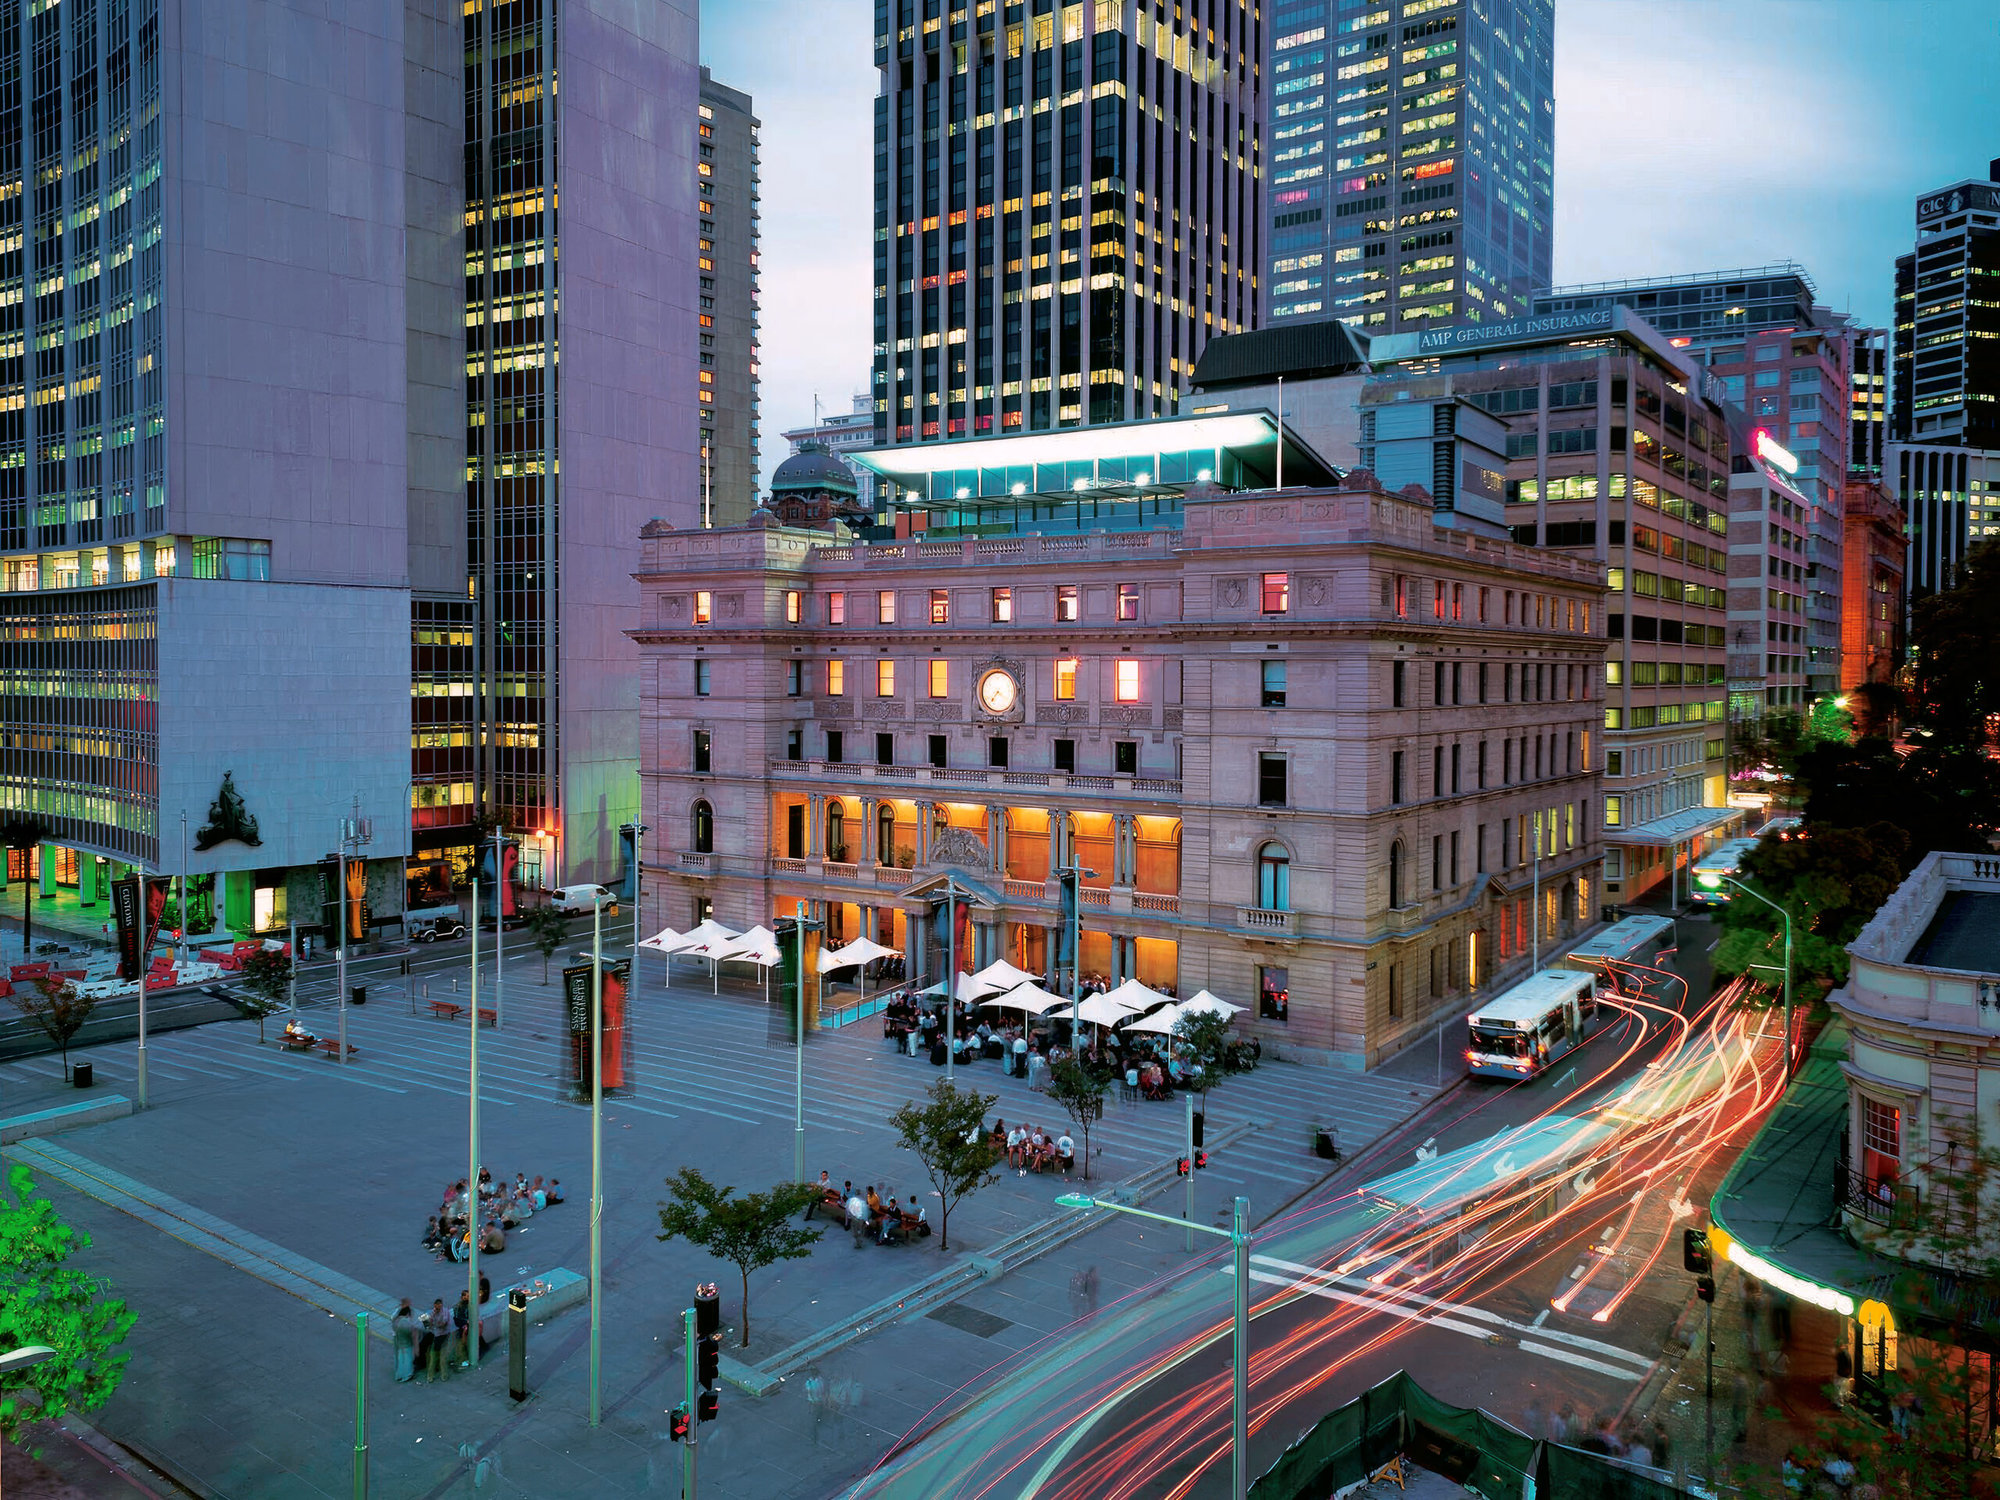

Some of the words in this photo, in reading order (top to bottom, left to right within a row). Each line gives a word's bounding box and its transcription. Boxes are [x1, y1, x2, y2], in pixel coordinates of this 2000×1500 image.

[1920, 196, 1945, 215] CIC
[1421, 332, 1452, 348] AMP
[1456, 323, 1523, 343] GENERAL
[1527, 310, 1612, 333] INSURANCE
[122, 888, 133, 927] CUSTOMS
